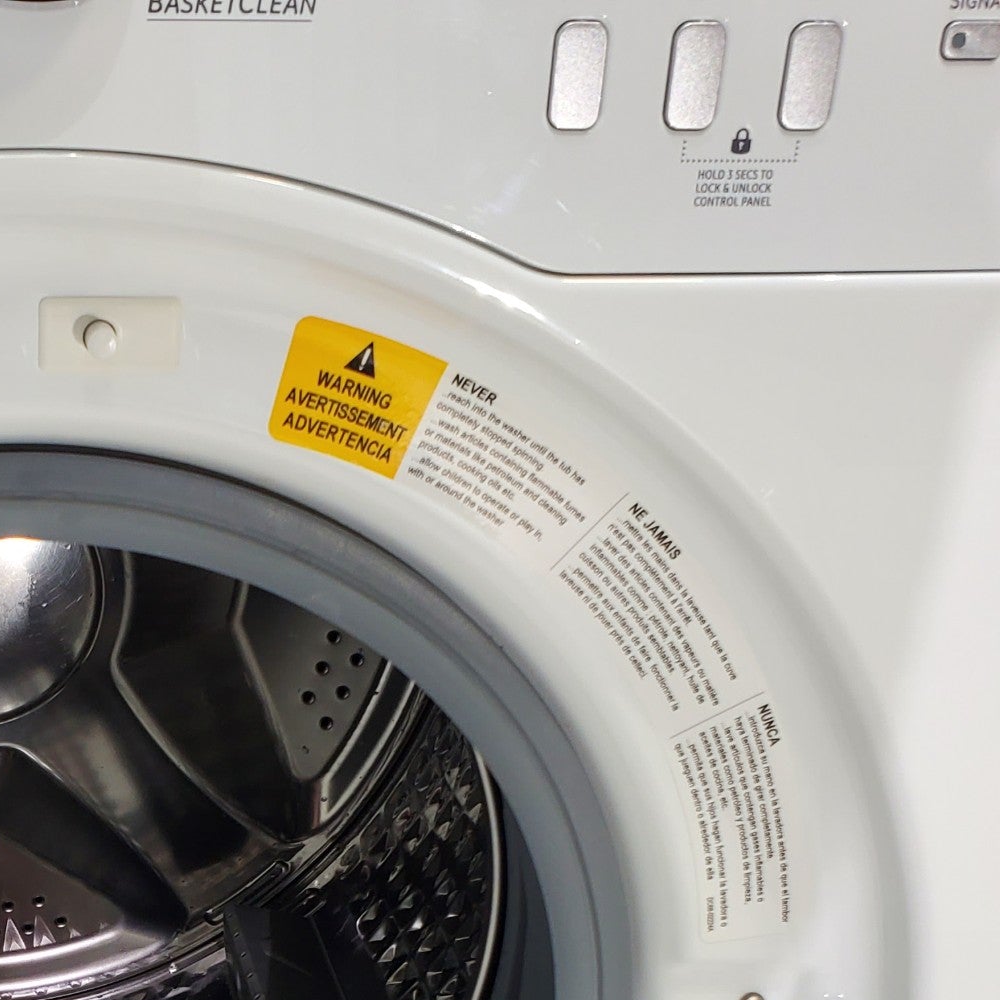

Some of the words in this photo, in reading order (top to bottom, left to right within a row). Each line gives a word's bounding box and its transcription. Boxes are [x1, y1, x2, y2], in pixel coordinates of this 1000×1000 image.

[697, 169, 725, 179] HOLD
[727, 169, 733, 179] 3
[735, 169, 758, 179] SECS
[760, 169, 772, 179] TO
[695, 183, 720, 193] LOCK
[732, 183, 771, 193] UNLOCK
[693, 196, 738, 206] CONTROL
[741, 196, 771, 206] PANEL
[315, 369, 393, 411] WARNING
[450, 373, 498, 406] NEVER
[284, 384, 409, 442] AVERTISSEMENT
[434, 399, 481, 432] completely
[478, 424, 513, 450] stopped
[282, 409, 394, 463] ADVERTENCIA
[470, 403, 488, 418] into
[487, 412, 502, 426] the
[500, 420, 530, 444] washer
[529, 439, 548, 456] until
[545, 450, 560, 465] the
[558, 460, 572, 475] tub
[570, 469, 586, 486] has
[423, 427, 434, 437] or
[434, 431, 472, 457] materials
[470, 451, 487, 466] like
[484, 460, 525, 492] petroleum
[522, 485, 540, 502] and
[536, 496, 568, 527] cleaning
[454, 458, 488, 484] cooking
[486, 476, 502, 491] oils
[460, 429, 490, 451] articles
[487, 446, 530, 479] containing
[563, 498, 585, 522] fumes
[406, 464, 426, 479] with
[424, 475, 434, 484] or
[434, 478, 464, 501] around
[462, 495, 477, 509] the
[440, 466, 473, 491] children
[471, 485, 482, 496] to
[479, 490, 511, 516] operate
[509, 511, 519, 521] or
[516, 515, 536, 535] play
[627, 502, 648, 522] NE
[642, 517, 682, 561] JAMAIS
[620, 539, 636, 554] pas
[640, 539, 654, 553] les
[649, 550, 671, 573] mains
[666, 570, 684, 591] dans
[679, 588, 689, 598] la
[684, 596, 708, 626] laveuse
[702, 623, 716, 640] tant
[709, 639, 723, 656] que
[719, 652, 729, 663] la
[723, 662, 736, 681] cuve
[757, 703, 781, 747] NUNCA
[760, 755, 768, 765] su
[763, 765, 773, 787] mano
[768, 788, 776, 798] en
[770, 798, 779, 807] la
[772, 806, 785, 839] lavadora
[778, 840, 787, 861] antes
[780, 862, 788, 872] de
[778, 873, 787, 888] que
[781, 888, 789, 897] el
[781, 896, 789, 923] tambor
